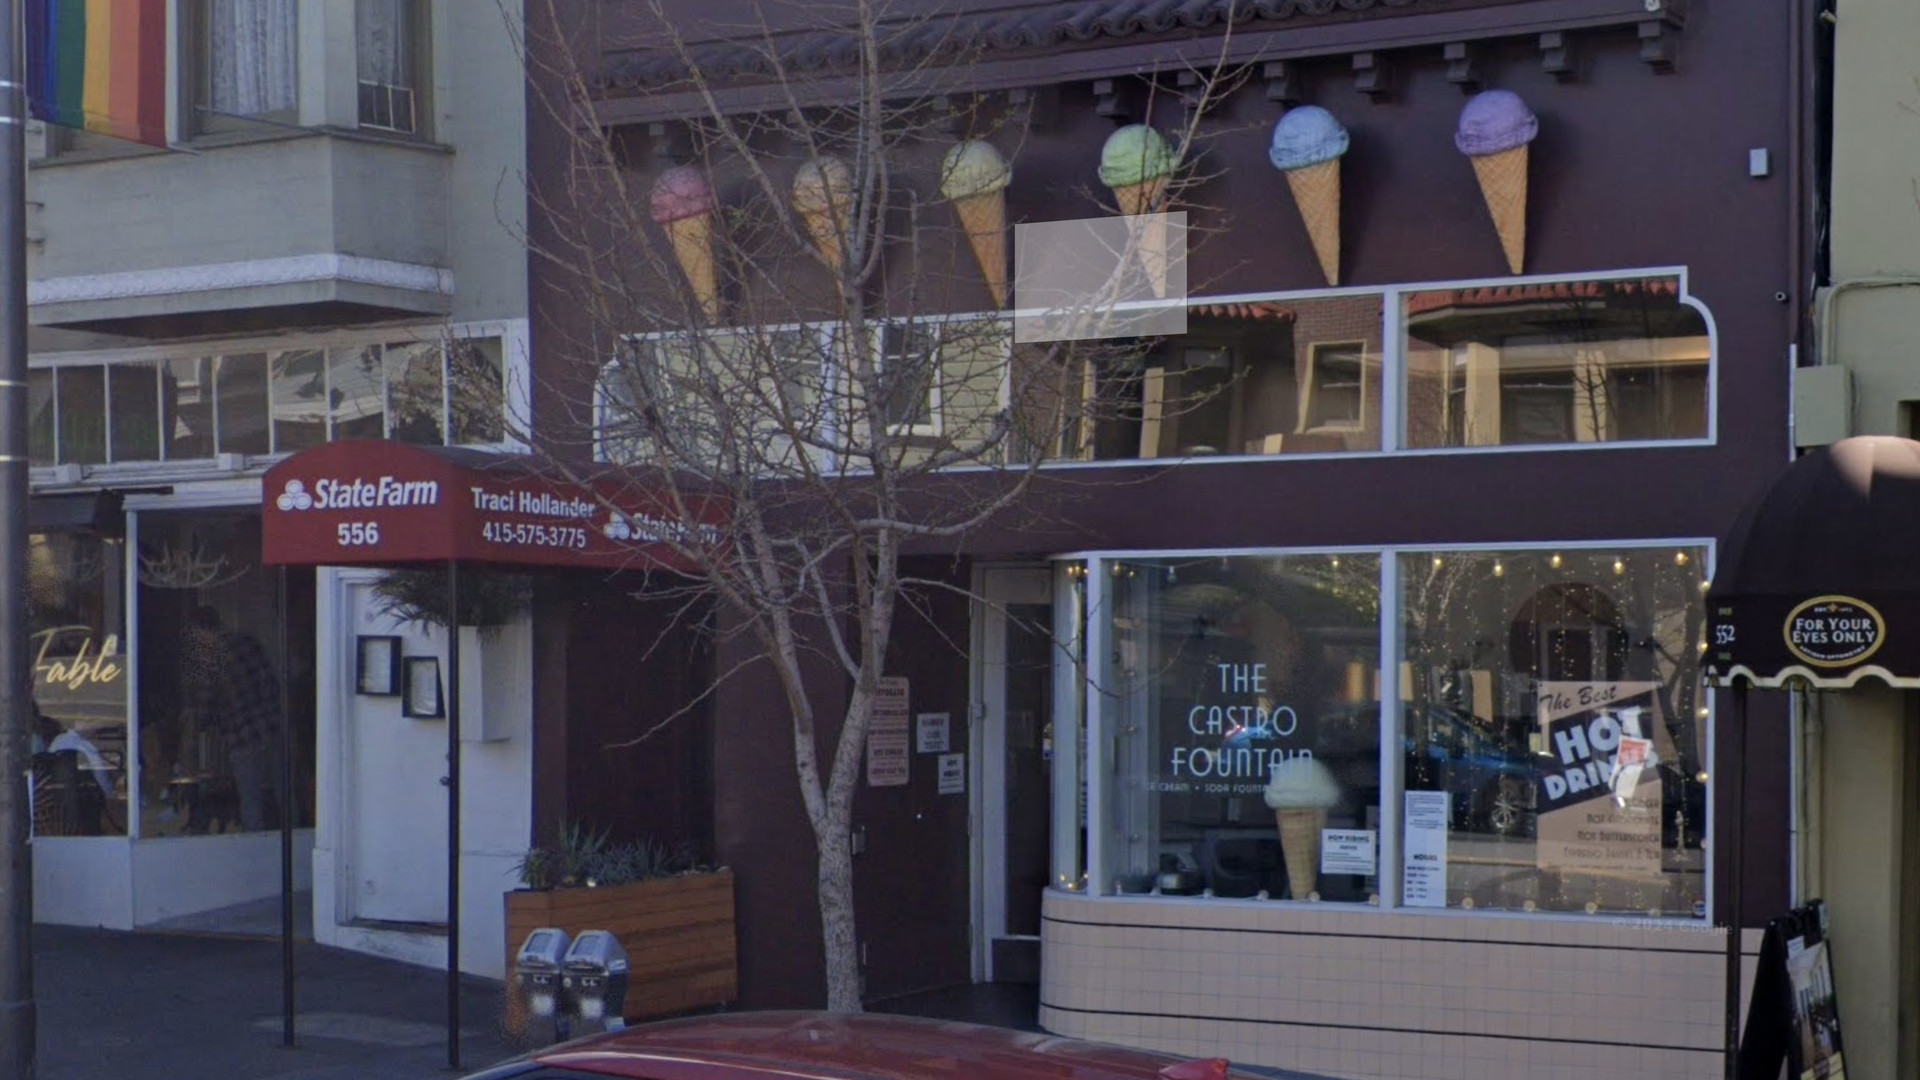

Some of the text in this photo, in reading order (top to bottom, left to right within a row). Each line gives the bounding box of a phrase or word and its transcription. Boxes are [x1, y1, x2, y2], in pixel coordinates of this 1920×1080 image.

[470, 486, 596, 517] Traci Hollander
[337, 521, 379, 546] 556
[482, 521, 586, 549] 415-575-3775
[1715, 624, 1736, 645] 552
[1792, 631, 1876, 643] EYES ONLY
[30, 625, 121, 690] Fable
[1218, 664, 1267, 693] THE
[1540, 686, 1618, 712] The Best
[1188, 705, 1298, 737] CASTRO
[1554, 705, 1643, 765] HOT
